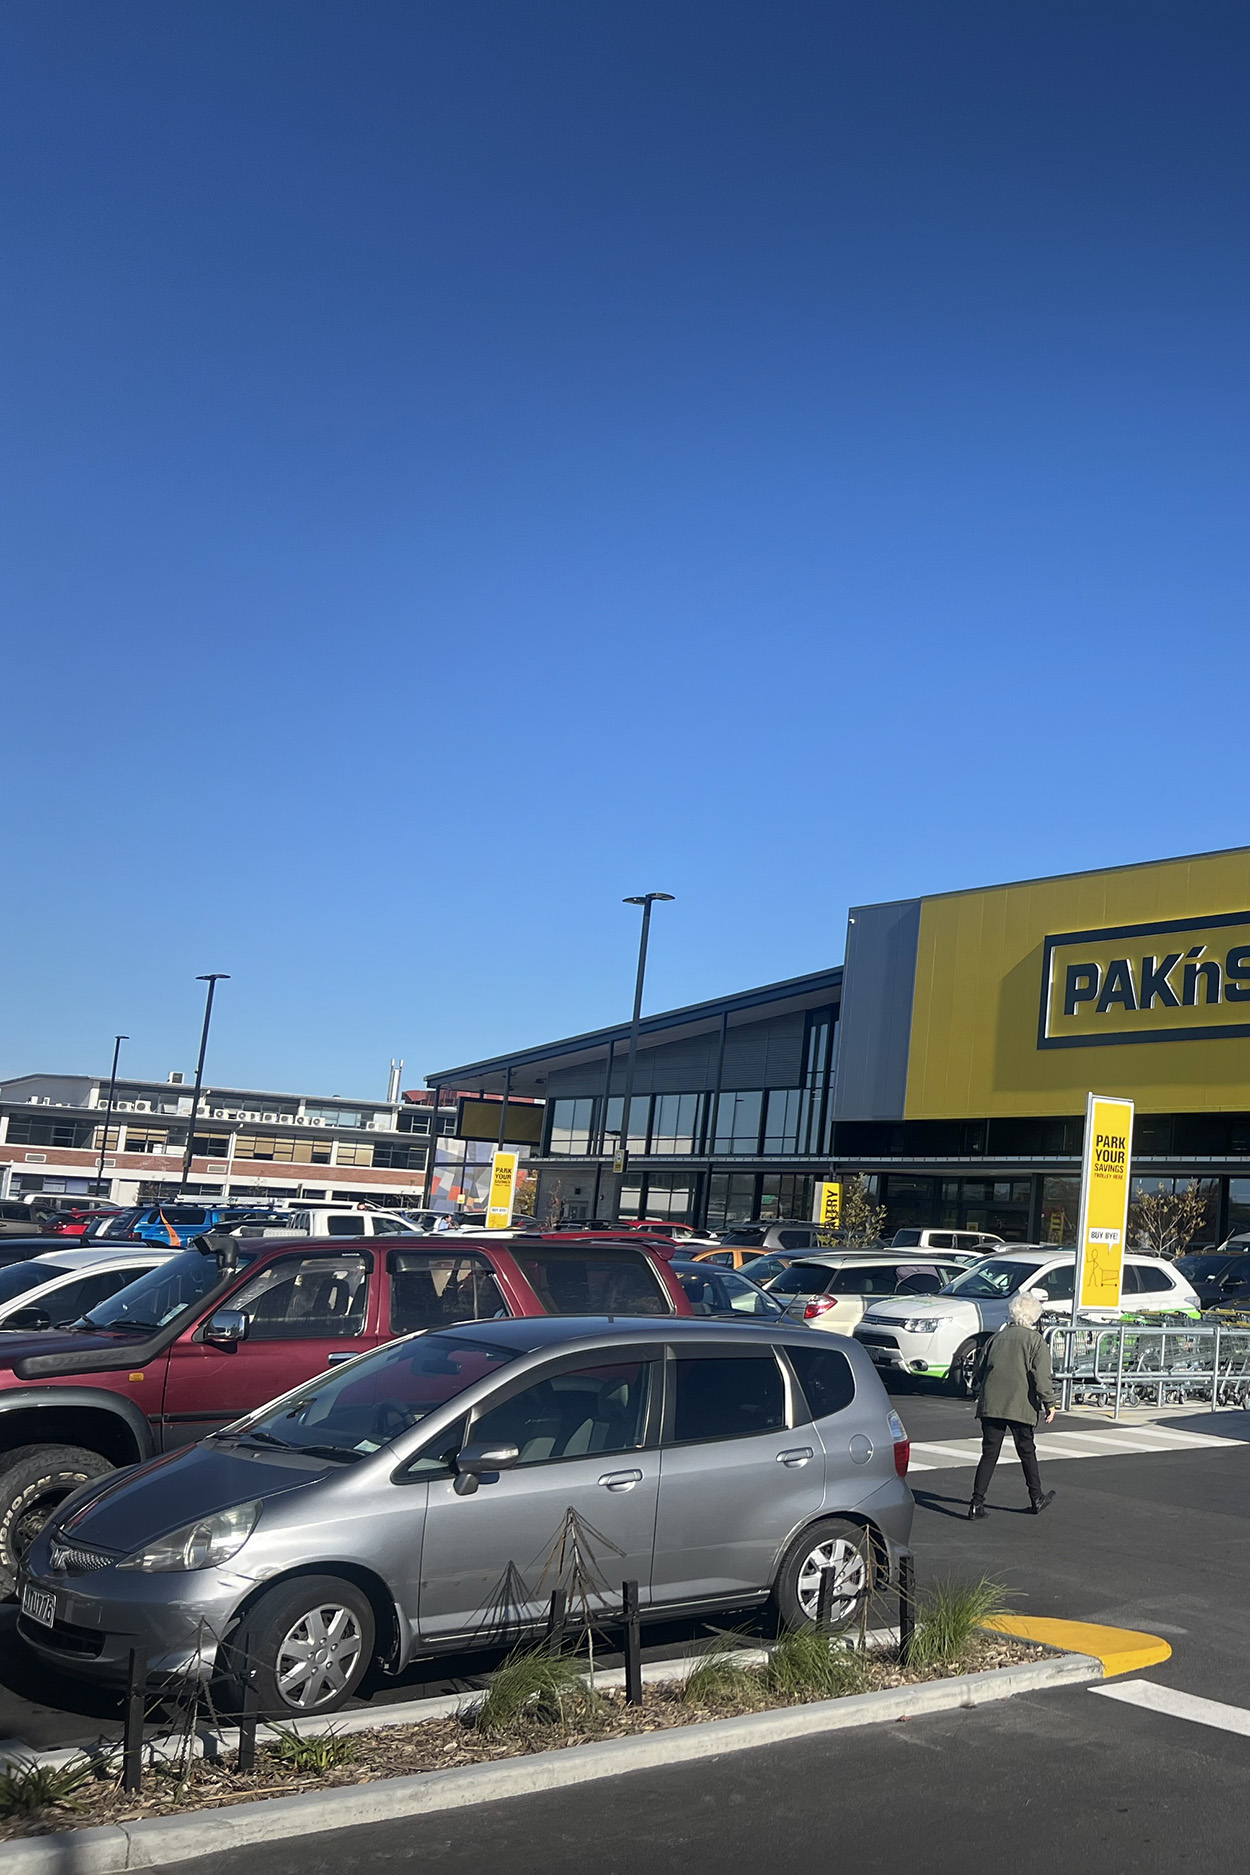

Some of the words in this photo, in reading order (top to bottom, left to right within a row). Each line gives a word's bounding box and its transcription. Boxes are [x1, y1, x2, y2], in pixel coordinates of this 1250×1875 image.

[1096, 1134, 1126, 1149] PARK
[1095, 1149, 1125, 1163] YOUR
[1094, 1163, 1124, 1173] SAVINGS
[825, 1189, 838, 1229] NTRY
[1091, 1231, 1103, 1239] BUY
